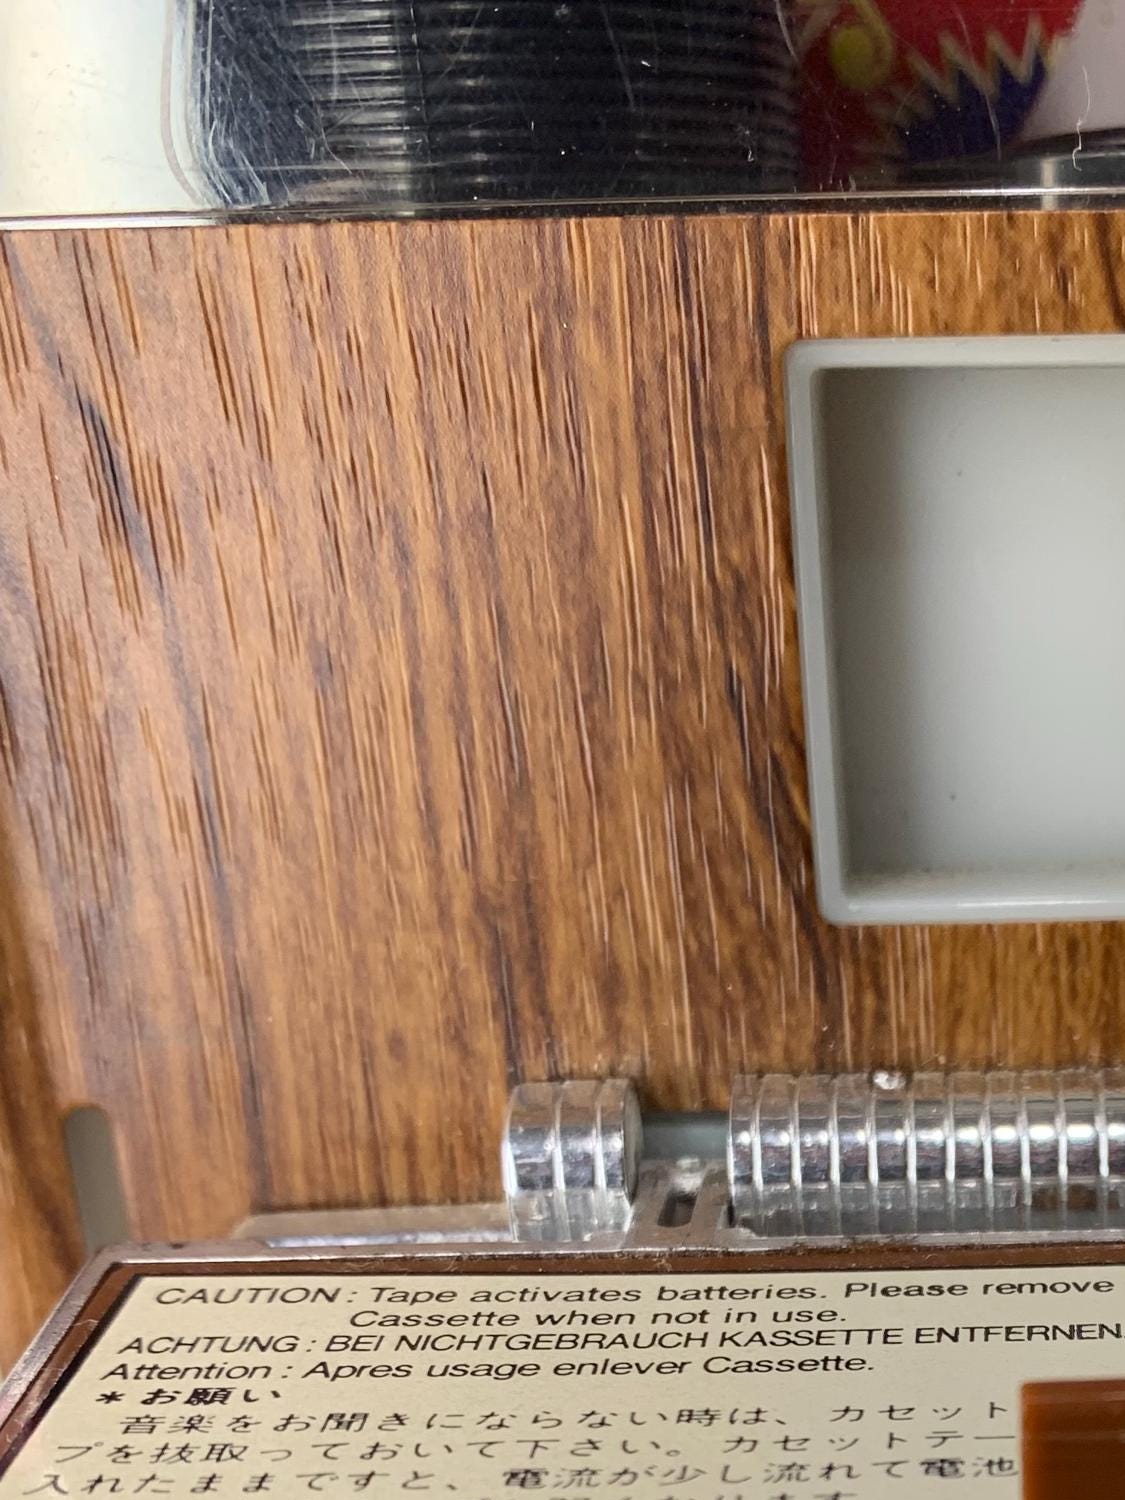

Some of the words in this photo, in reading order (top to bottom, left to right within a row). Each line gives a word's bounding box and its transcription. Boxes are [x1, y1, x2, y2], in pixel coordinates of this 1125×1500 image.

[369, 1286, 459, 1307] Tape
[469, 1286, 642, 1304] activates
[656, 1283, 827, 1302] batteries.
[843, 1281, 969, 1299] Please
[982, 1280, 1115, 1296] remove
[349, 1309, 521, 1328] Cassette
[535, 1309, 636, 1327] when
[650, 1308, 711, 1325] not
[723, 1307, 758, 1324] in
[771, 1309, 847, 1324] use.
[323, 1334, 386, 1353] BEI
[393, 1330, 710, 1352] NICHTGEBRAUCH
[717, 1327, 905, 1348] KASSETTE
[300, 1360, 414, 1383] Apres
[425, 1362, 542, 1381] usage
[552, 1357, 693, 1377] enlever
[702, 1354, 875, 1375] Cassette.
